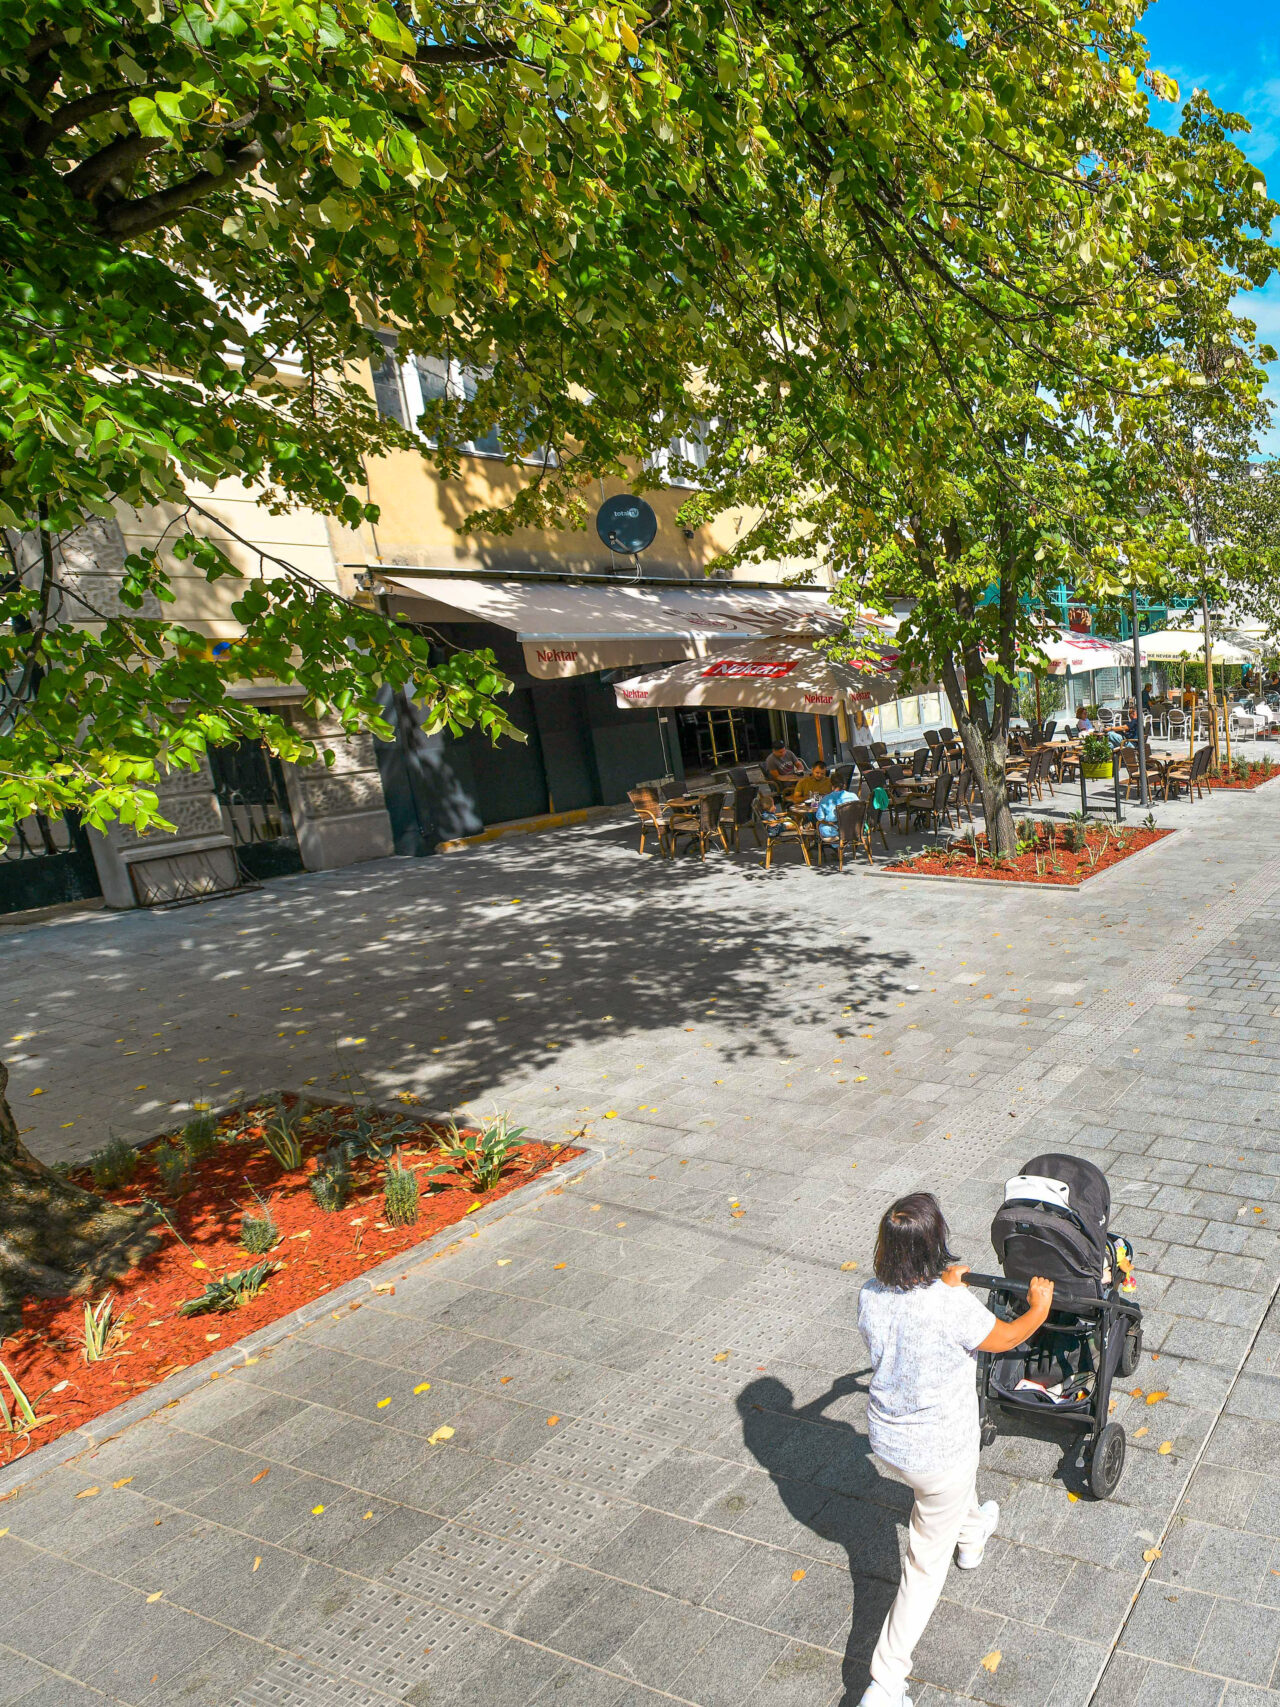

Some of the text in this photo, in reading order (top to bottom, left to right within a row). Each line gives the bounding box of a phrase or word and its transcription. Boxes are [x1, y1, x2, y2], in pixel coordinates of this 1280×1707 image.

[536, 649, 578, 662] Nektar
[713, 663, 787, 675] Nektar
[622, 689, 649, 699] Nektar
[804, 693, 833, 704] Nektar
[850, 691, 870, 701] Nektar
